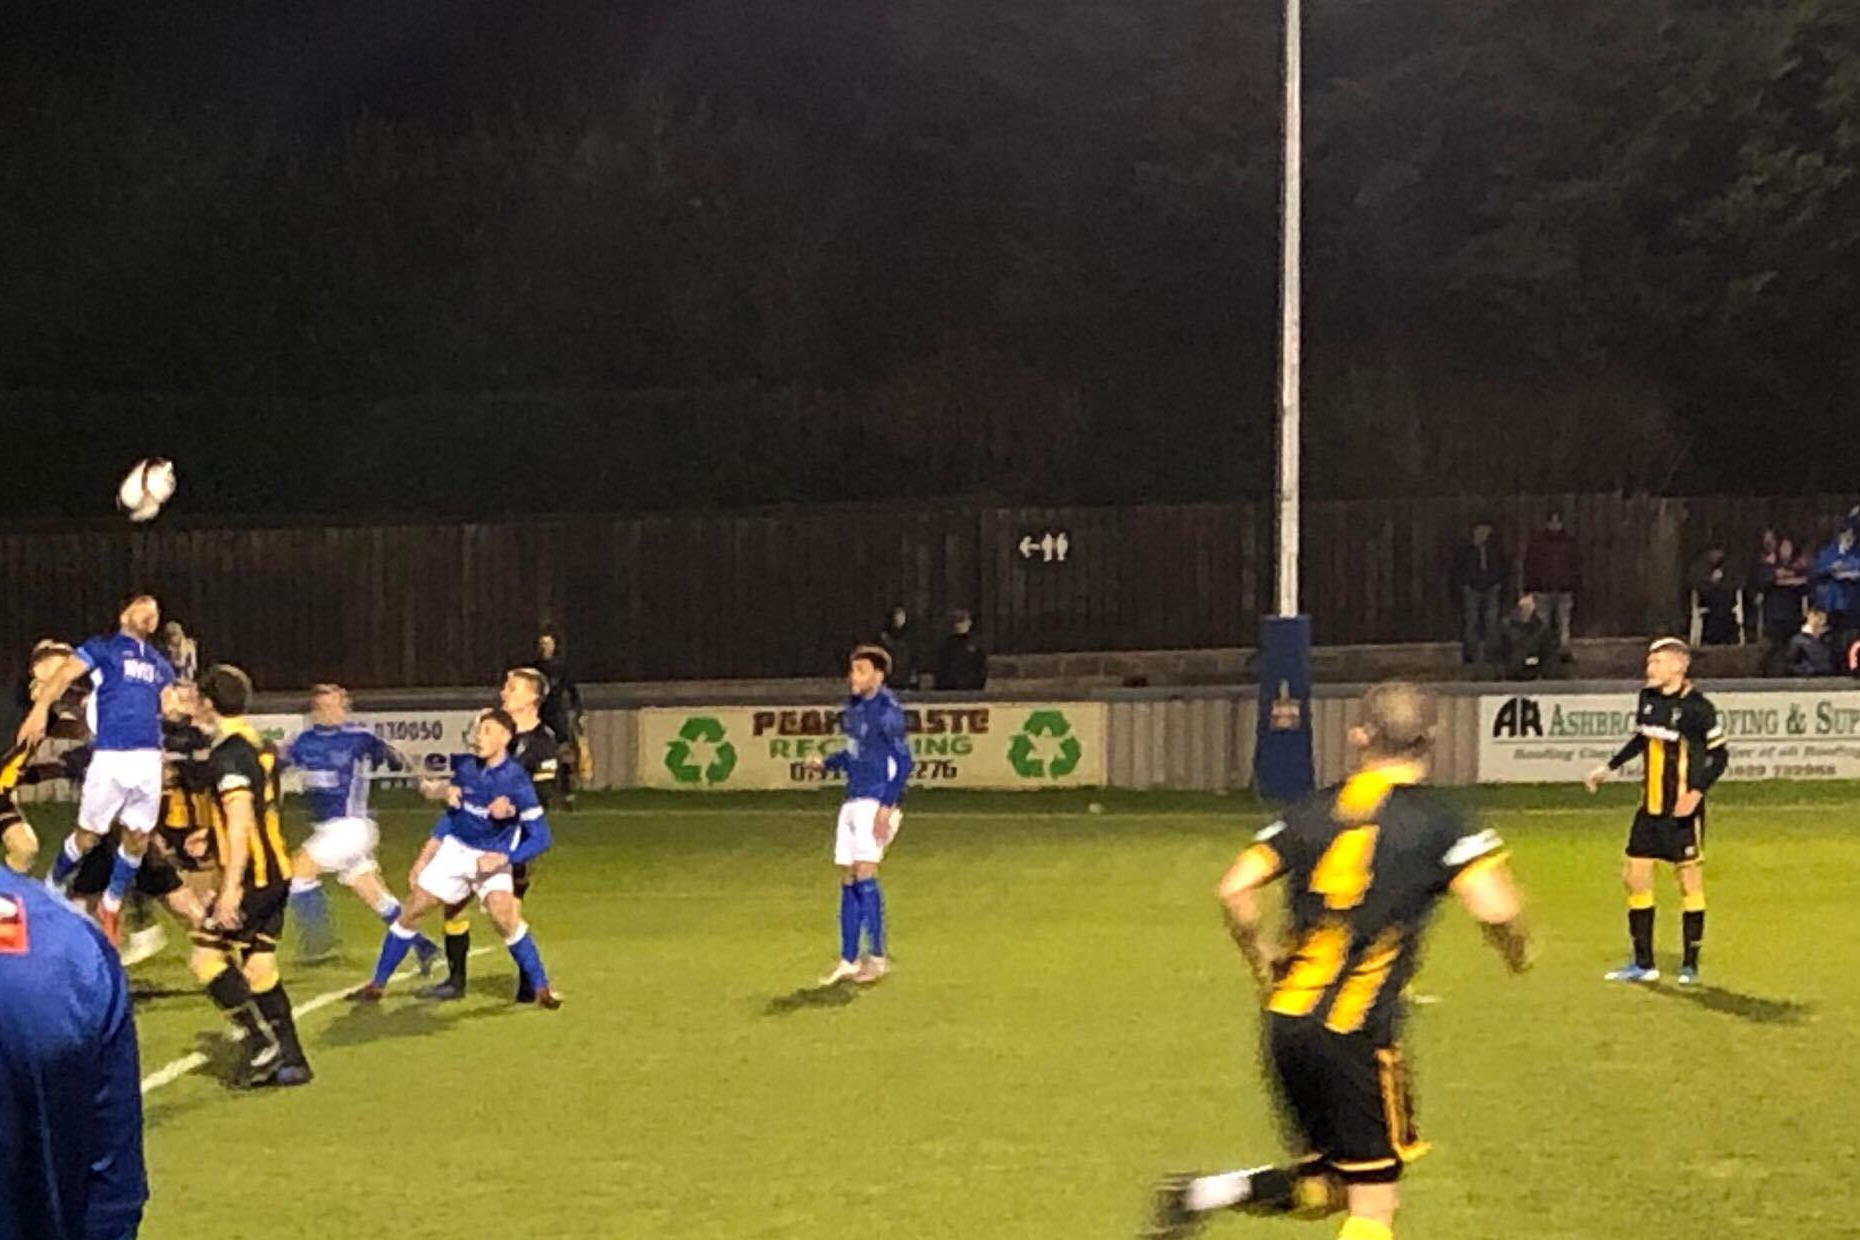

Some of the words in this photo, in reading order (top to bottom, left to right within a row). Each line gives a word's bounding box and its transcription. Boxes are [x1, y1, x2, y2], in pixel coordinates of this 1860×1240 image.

[904, 707, 989, 735] ASTE
[1786, 702, 1807, 735] &
[1814, 700, 1860, 735] SUP
